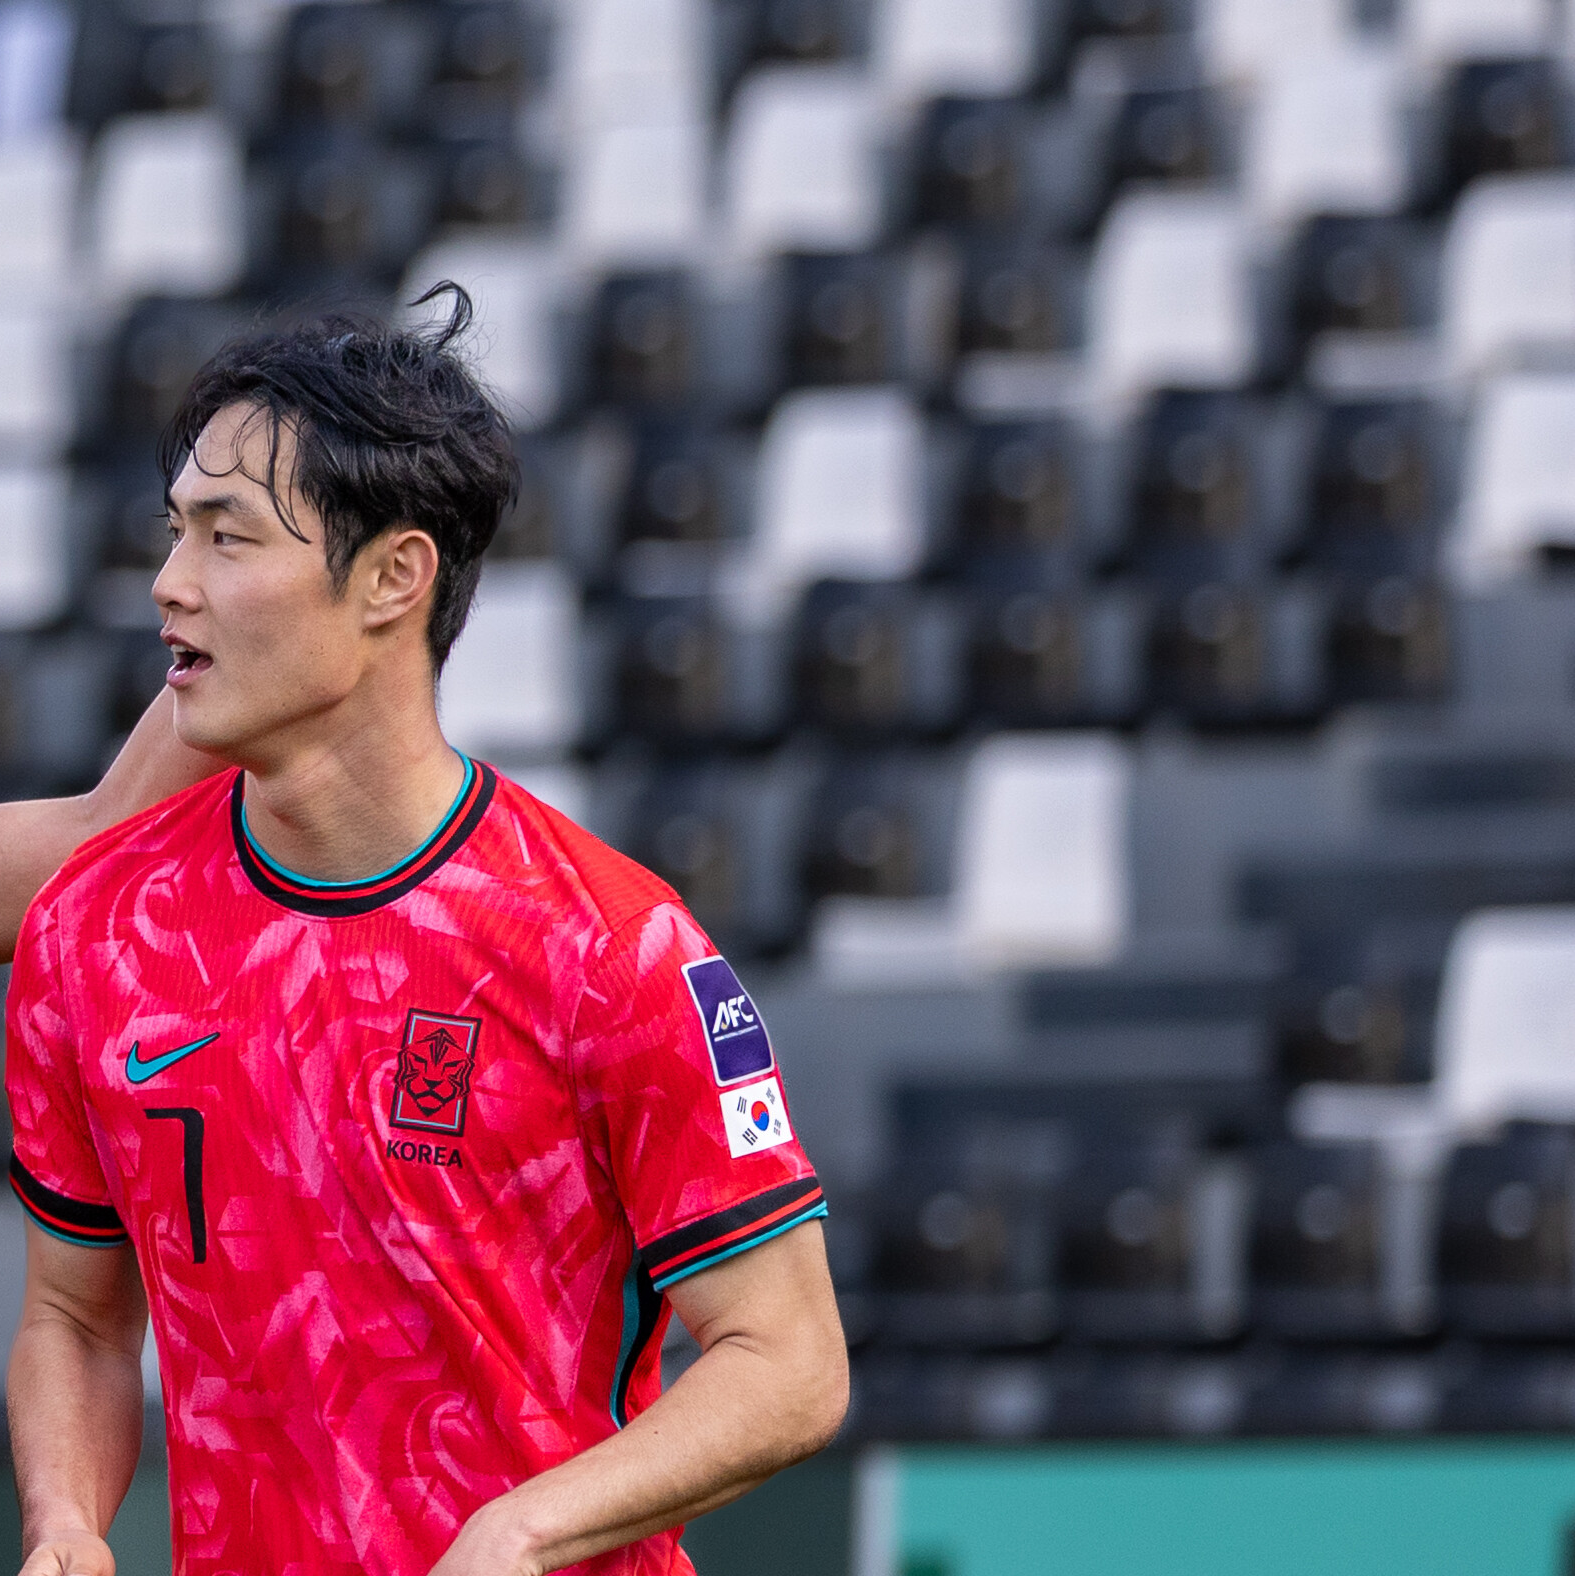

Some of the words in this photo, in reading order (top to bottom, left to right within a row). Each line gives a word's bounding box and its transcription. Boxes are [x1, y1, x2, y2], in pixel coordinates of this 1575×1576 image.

[712, 995, 754, 1034] AFC
[386, 1140, 463, 1169] KOREA
[144, 1107, 205, 1265] 7
